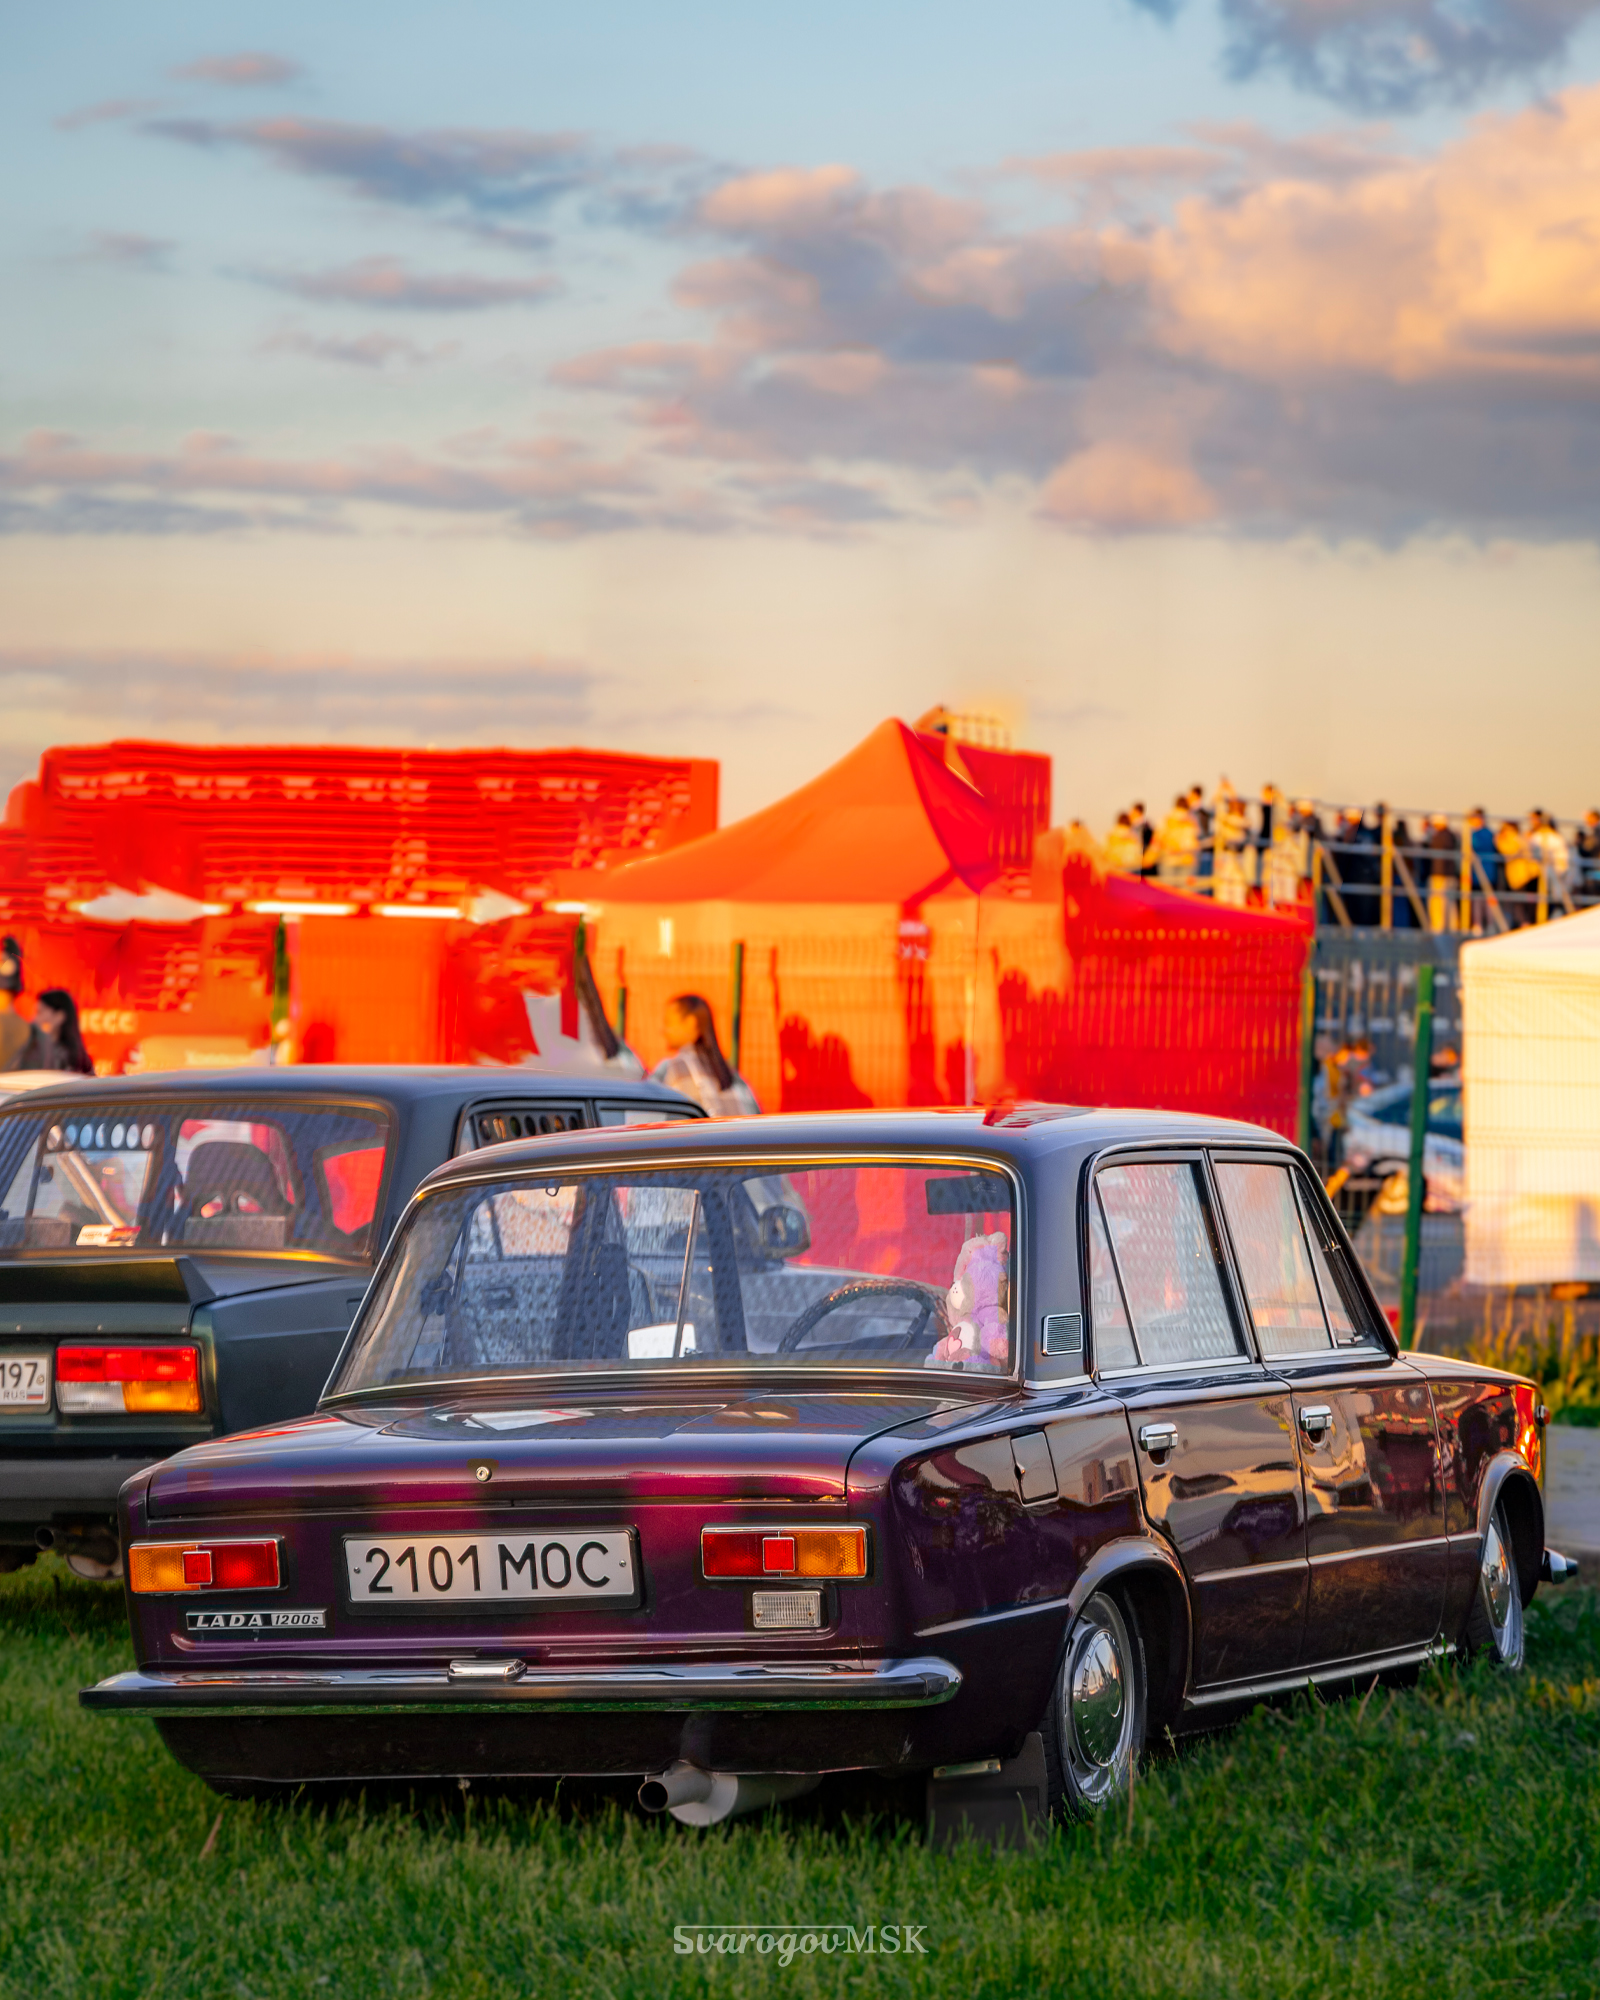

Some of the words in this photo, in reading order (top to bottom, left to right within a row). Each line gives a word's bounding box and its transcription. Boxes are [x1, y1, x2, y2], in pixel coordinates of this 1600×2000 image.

[0, 1362, 38, 1388] 197
[3, 1390, 26, 1400] RUS
[365, 1544, 481, 1593] 2101
[196, 1614, 263, 1627] LADA
